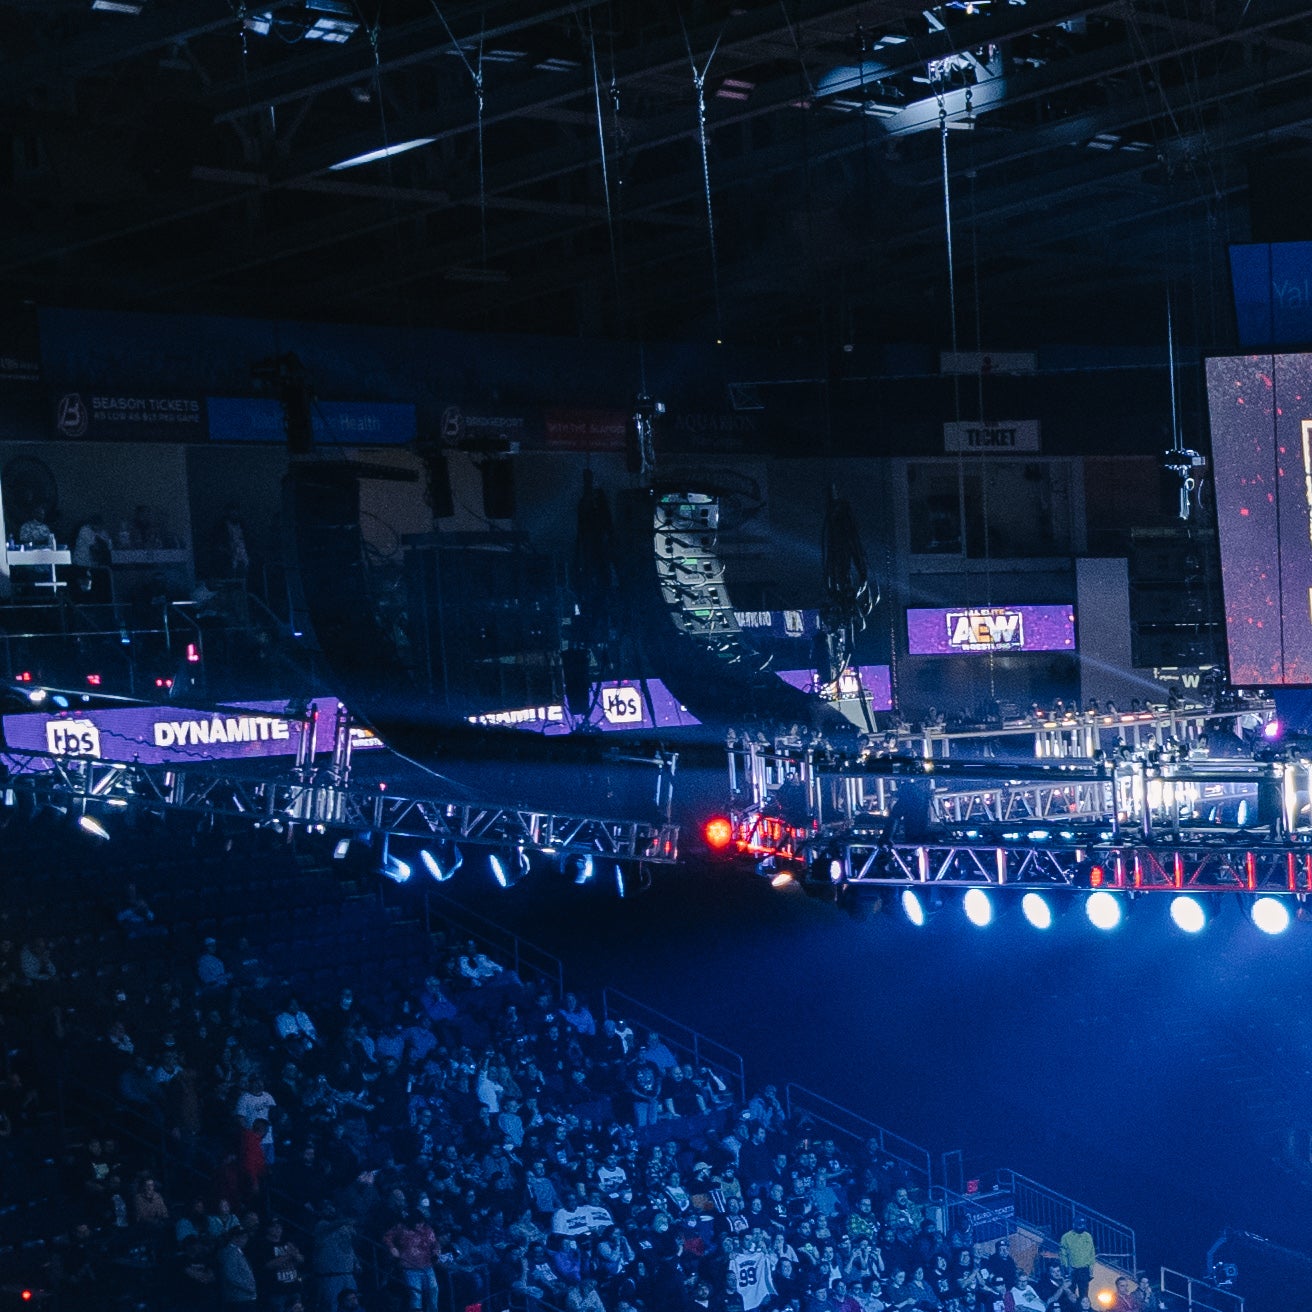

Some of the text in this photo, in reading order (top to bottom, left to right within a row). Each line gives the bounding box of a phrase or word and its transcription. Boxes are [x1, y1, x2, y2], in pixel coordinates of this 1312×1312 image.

[93, 398, 200, 412] SEASON TICKETS
[967, 429, 1016, 447] TICKET
[952, 615, 1019, 644] AEW
[156, 716, 292, 747] DYNAMITE
[739, 1267, 757, 1288] 99
